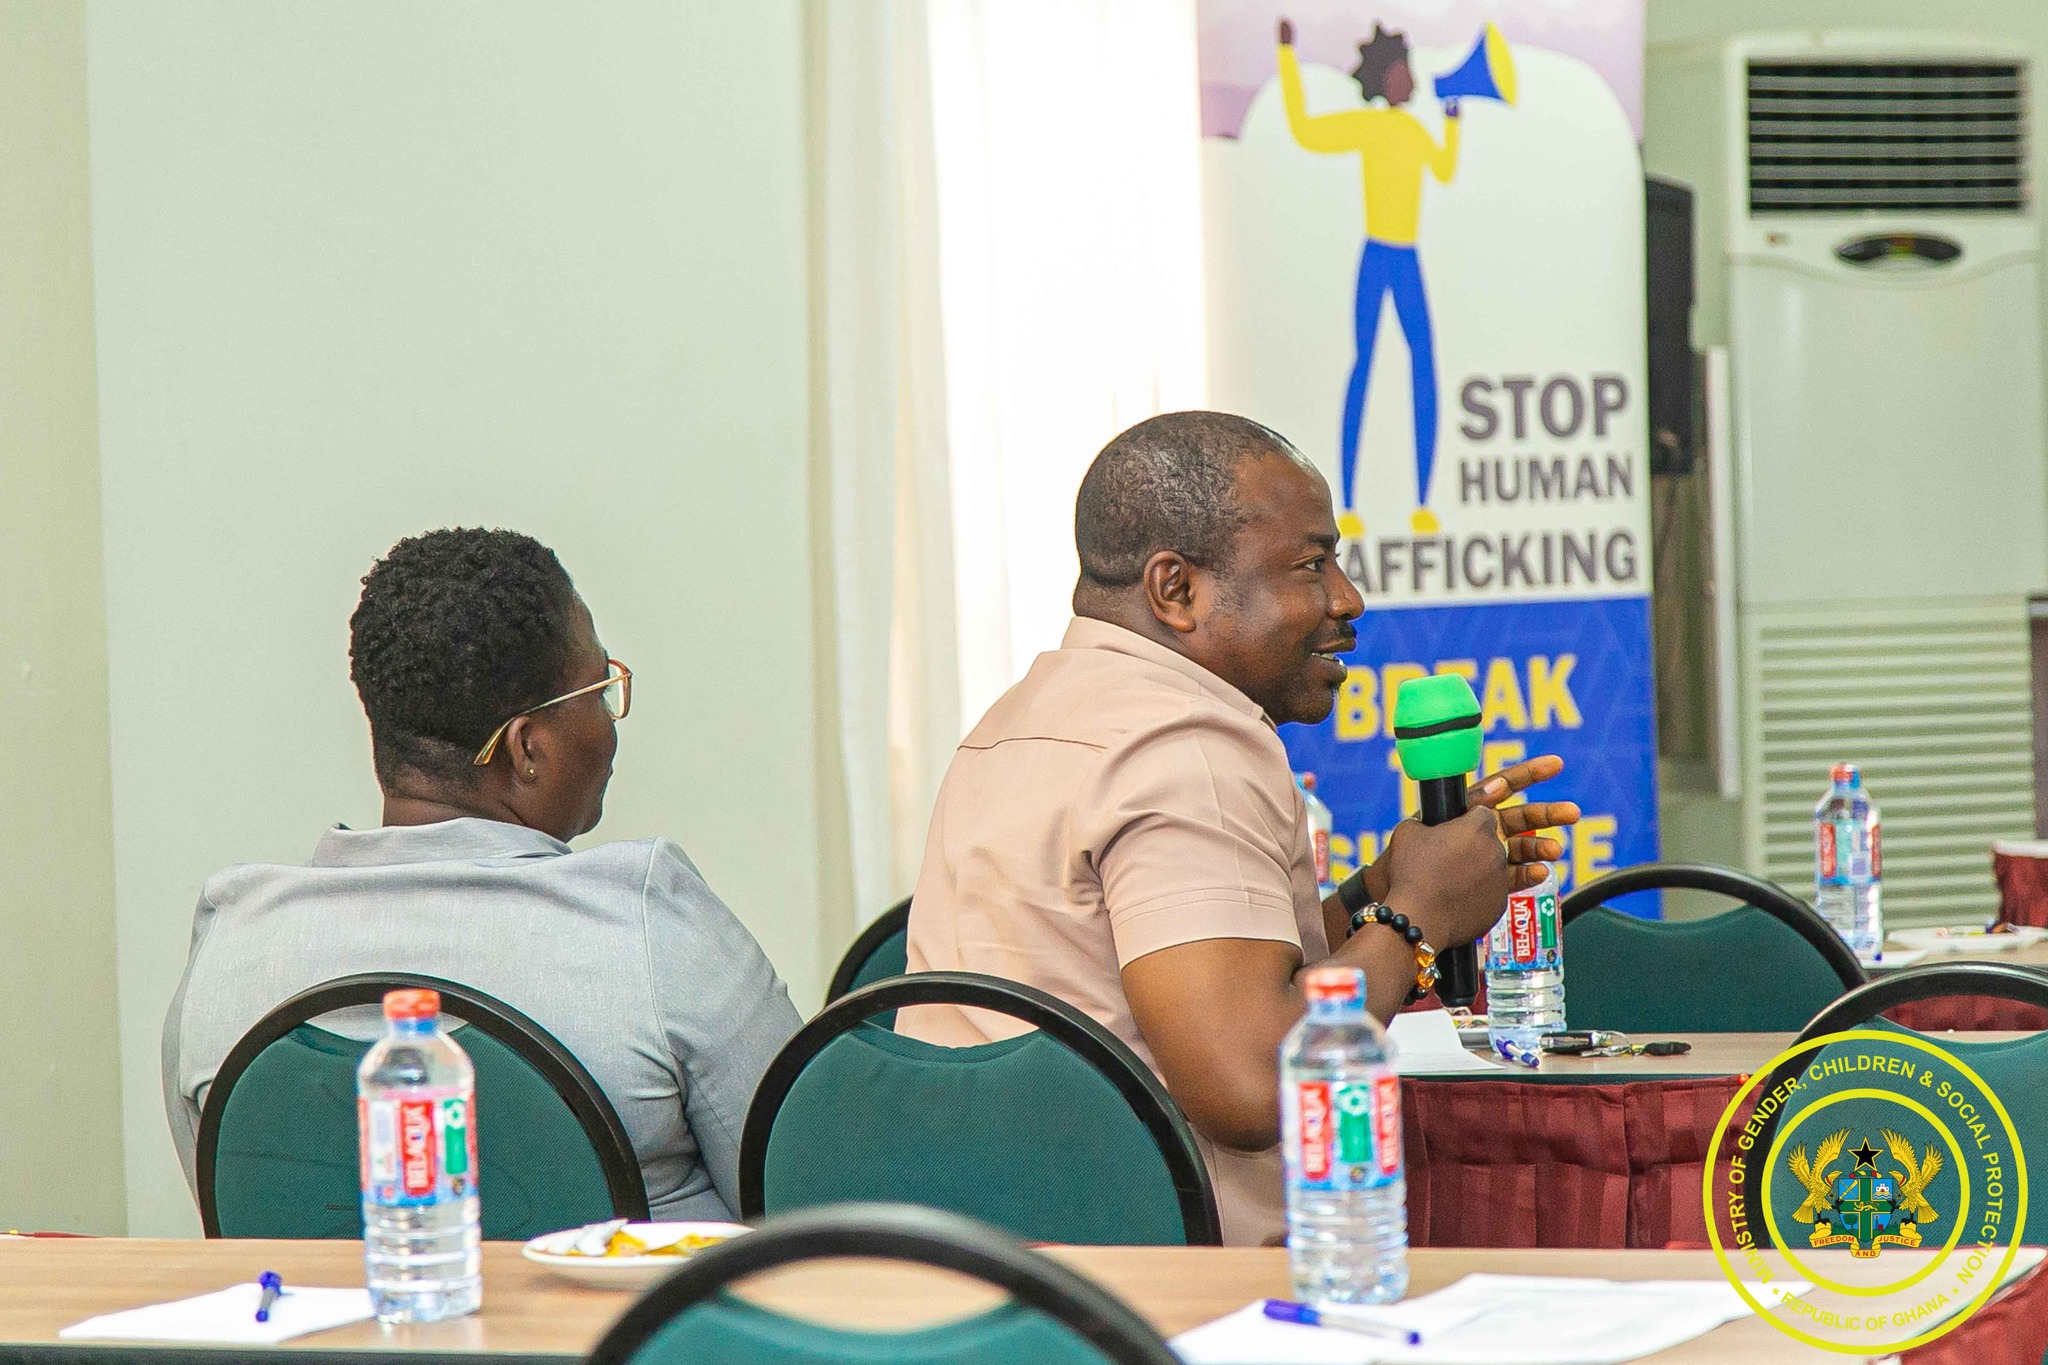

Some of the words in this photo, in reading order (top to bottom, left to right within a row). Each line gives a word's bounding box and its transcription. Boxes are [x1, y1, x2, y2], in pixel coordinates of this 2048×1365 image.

[1460, 375, 1630, 441] STOP
[1459, 453, 1635, 505] HUMAN
[1346, 531, 1638, 594] AFFICKING
[1335, 653, 1583, 741] BAK
[1513, 899, 1533, 957] BEL-AQUA
